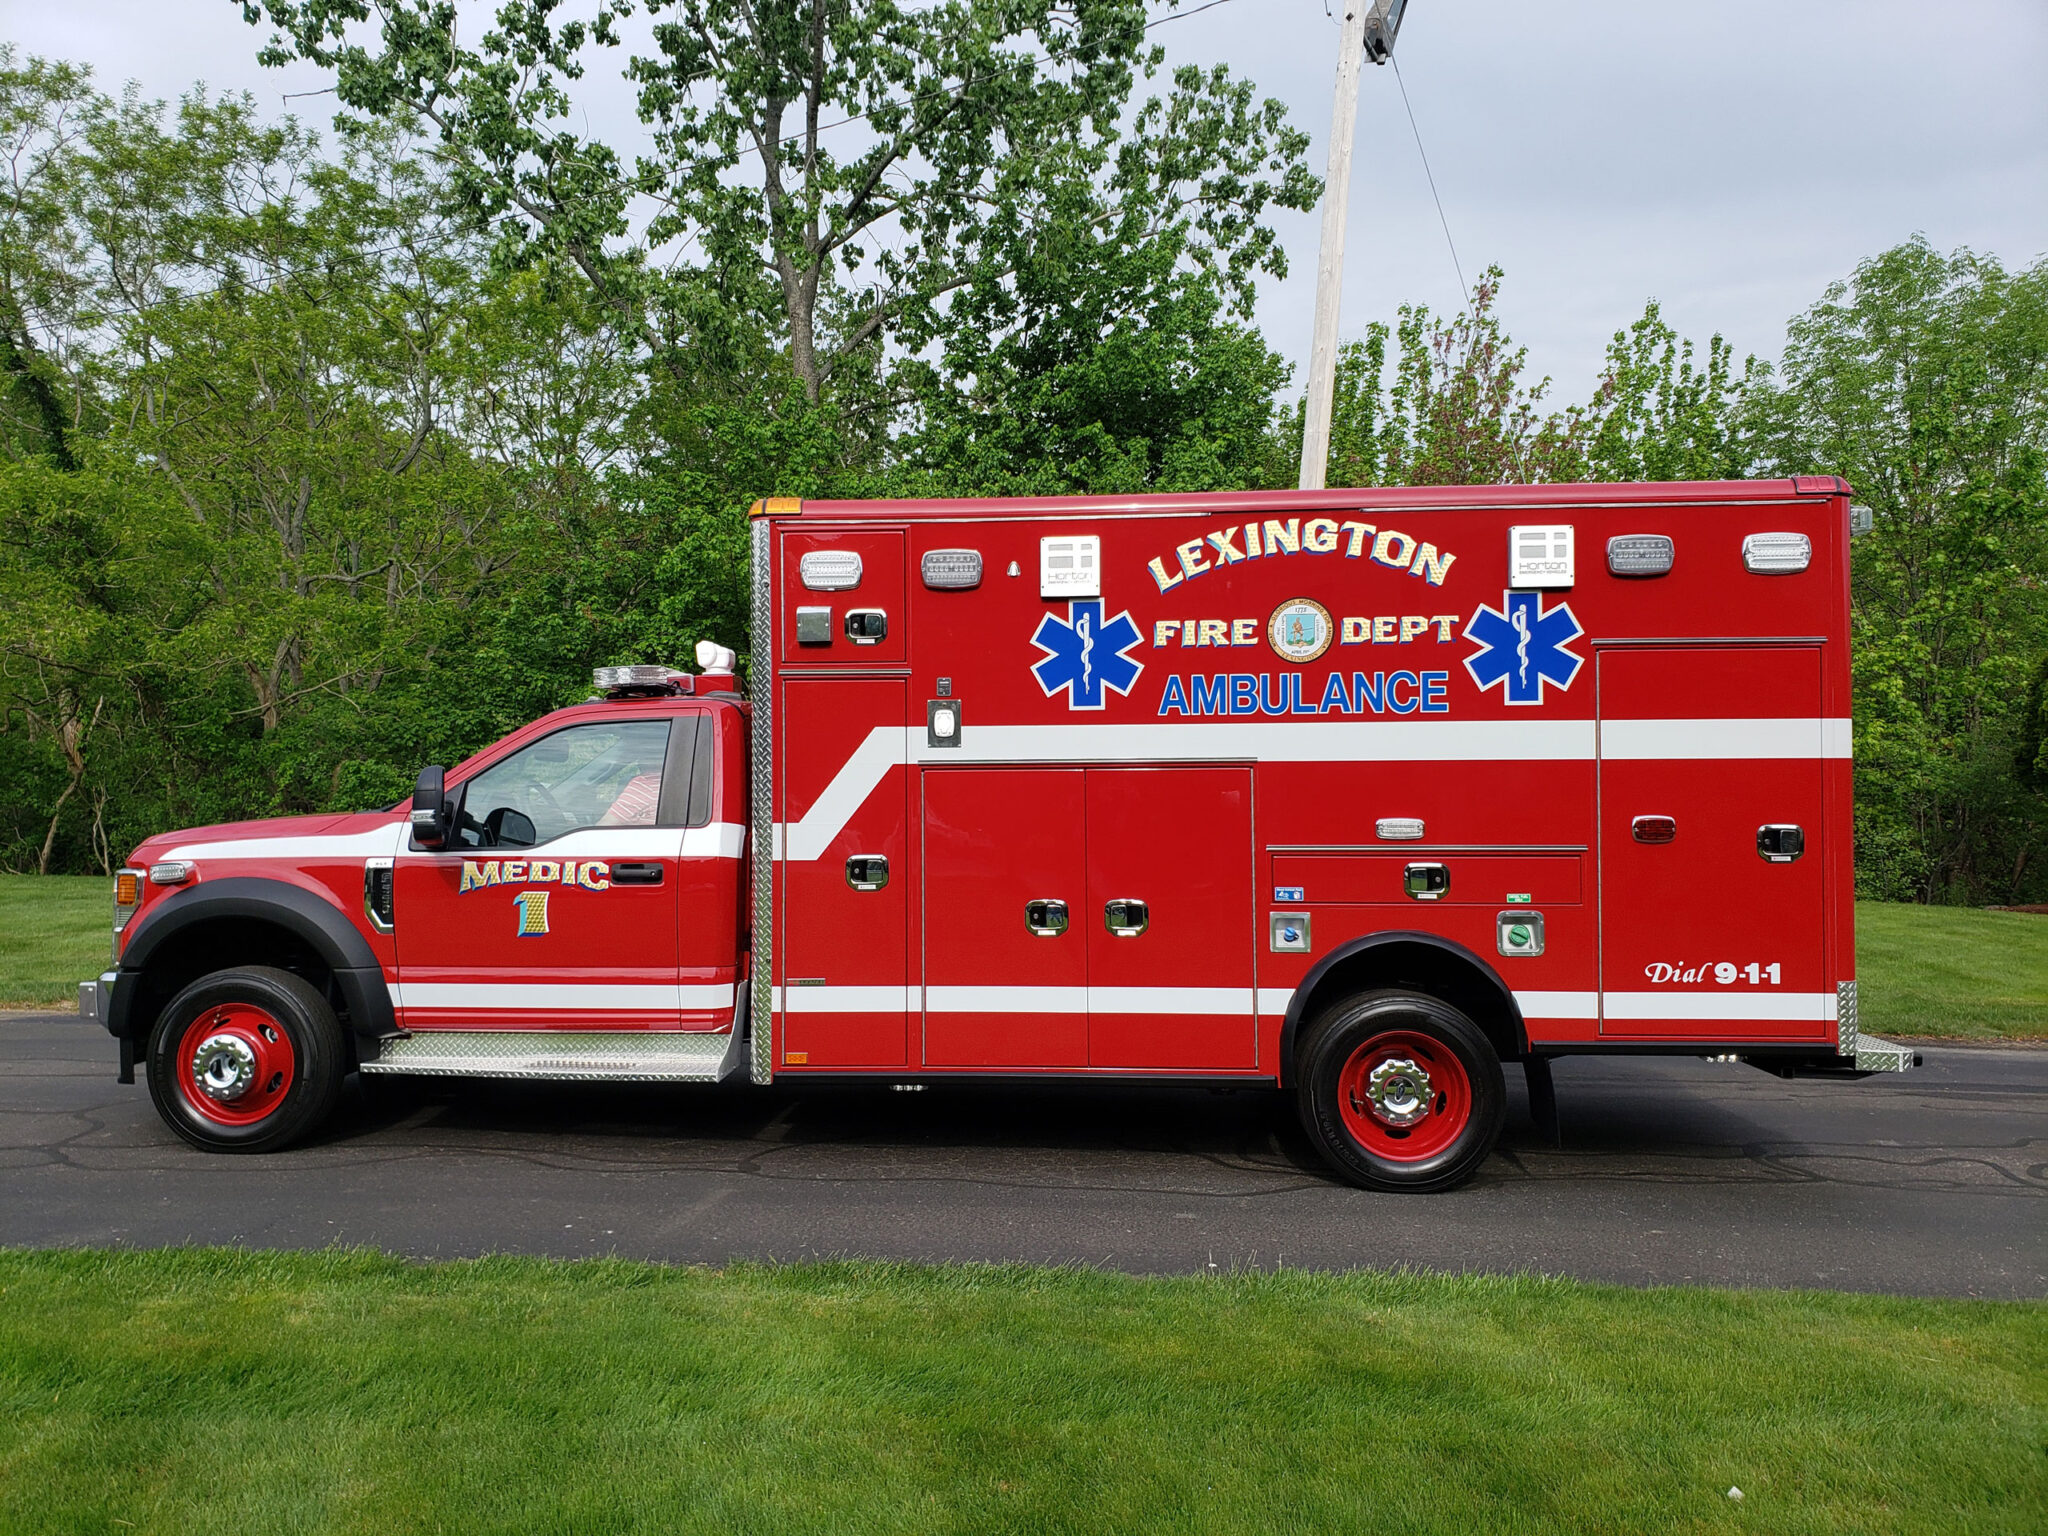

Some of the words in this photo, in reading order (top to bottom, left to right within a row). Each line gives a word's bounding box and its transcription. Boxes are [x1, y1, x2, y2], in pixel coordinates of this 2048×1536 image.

[1147, 518, 1457, 595] LEXINGTON
[1519, 562, 1567, 570] Horton
[1153, 618, 1259, 648] FIRE
[1157, 671, 1450, 716] AMBULANCE
[459, 861, 610, 895] MEDIC
[513, 891, 550, 937] 1
[1644, 960, 1713, 983] Dial
[1714, 962, 1781, 984] 9-1-1
